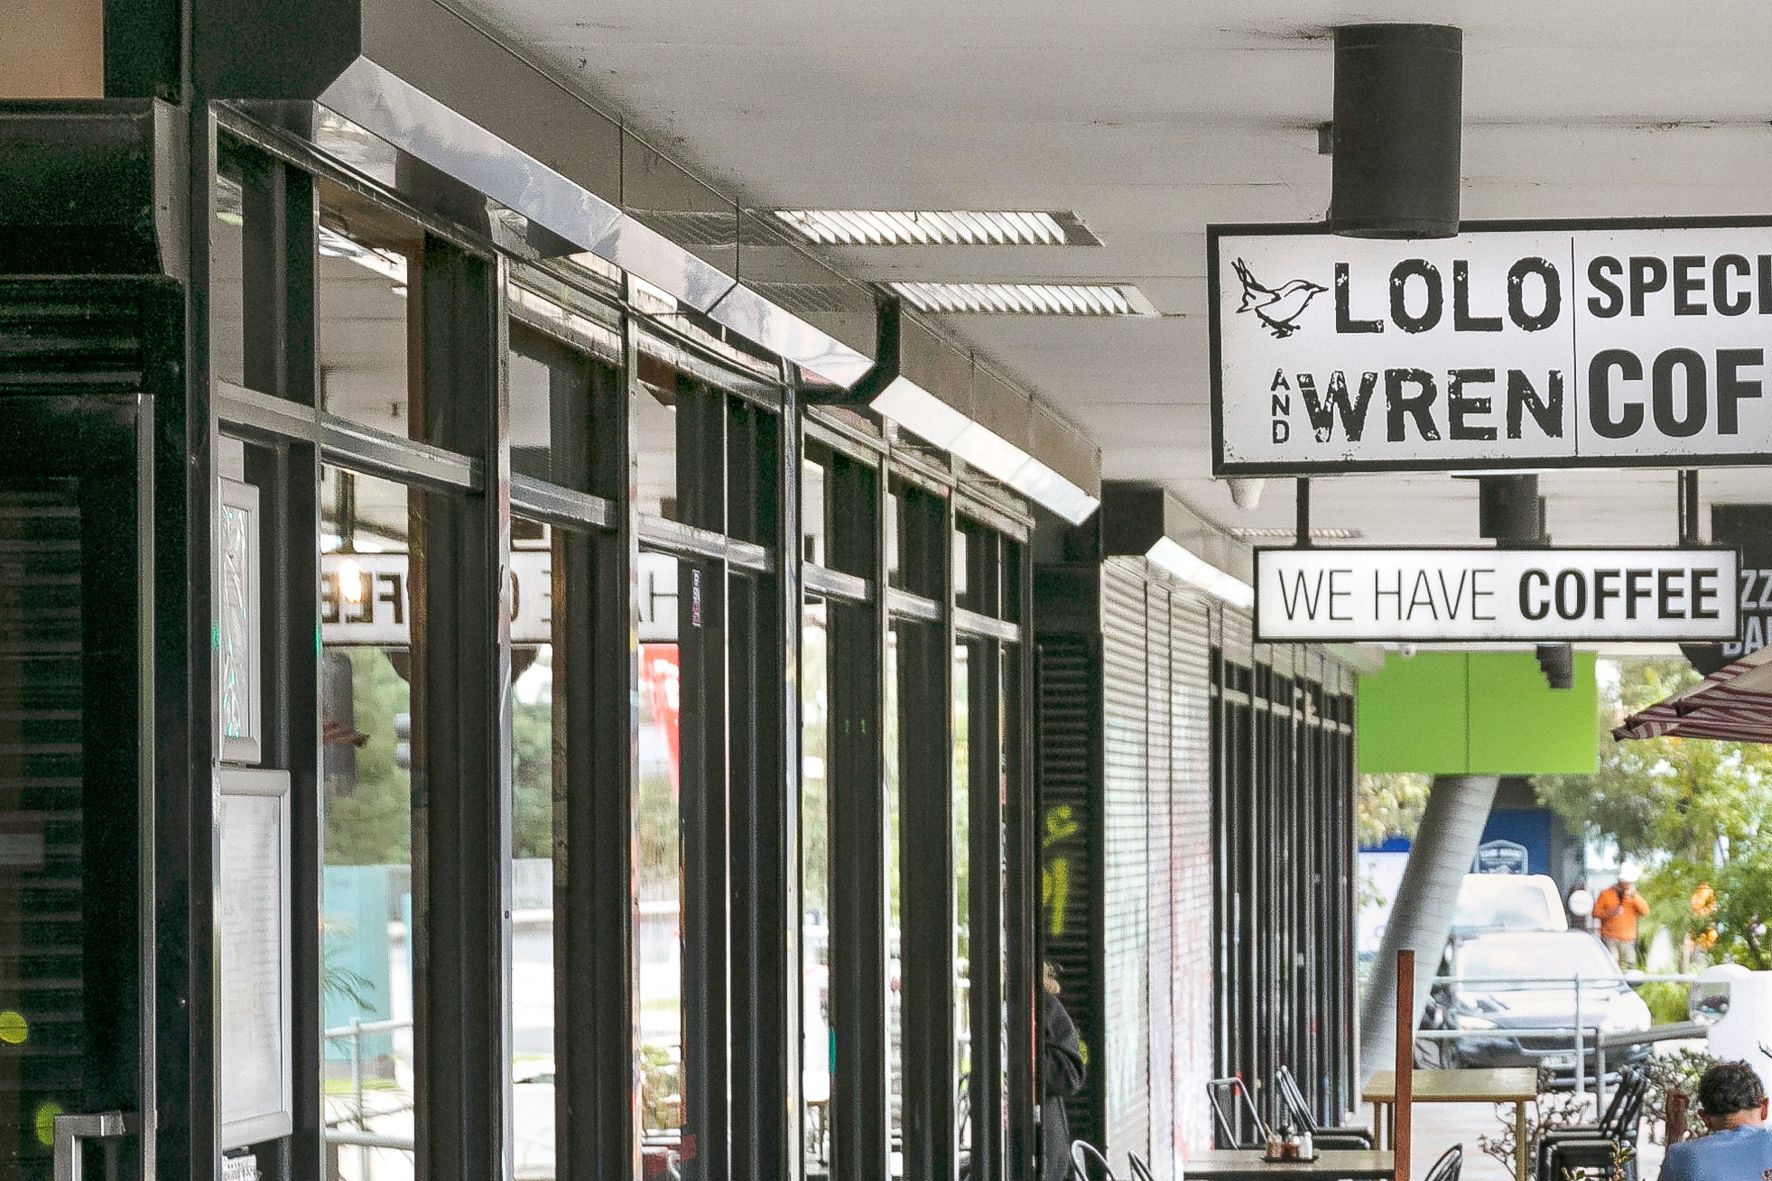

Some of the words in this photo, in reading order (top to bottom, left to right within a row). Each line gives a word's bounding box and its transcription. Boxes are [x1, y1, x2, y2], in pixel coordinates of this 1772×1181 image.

[1334, 256, 1561, 334] LOLO
[1270, 368, 1291, 444] AND
[1296, 368, 1564, 443] WREN
[1278, 569, 1353, 620] WE
[1374, 569, 1496, 620] HAVE
[1518, 568, 1719, 620] COFFEE
